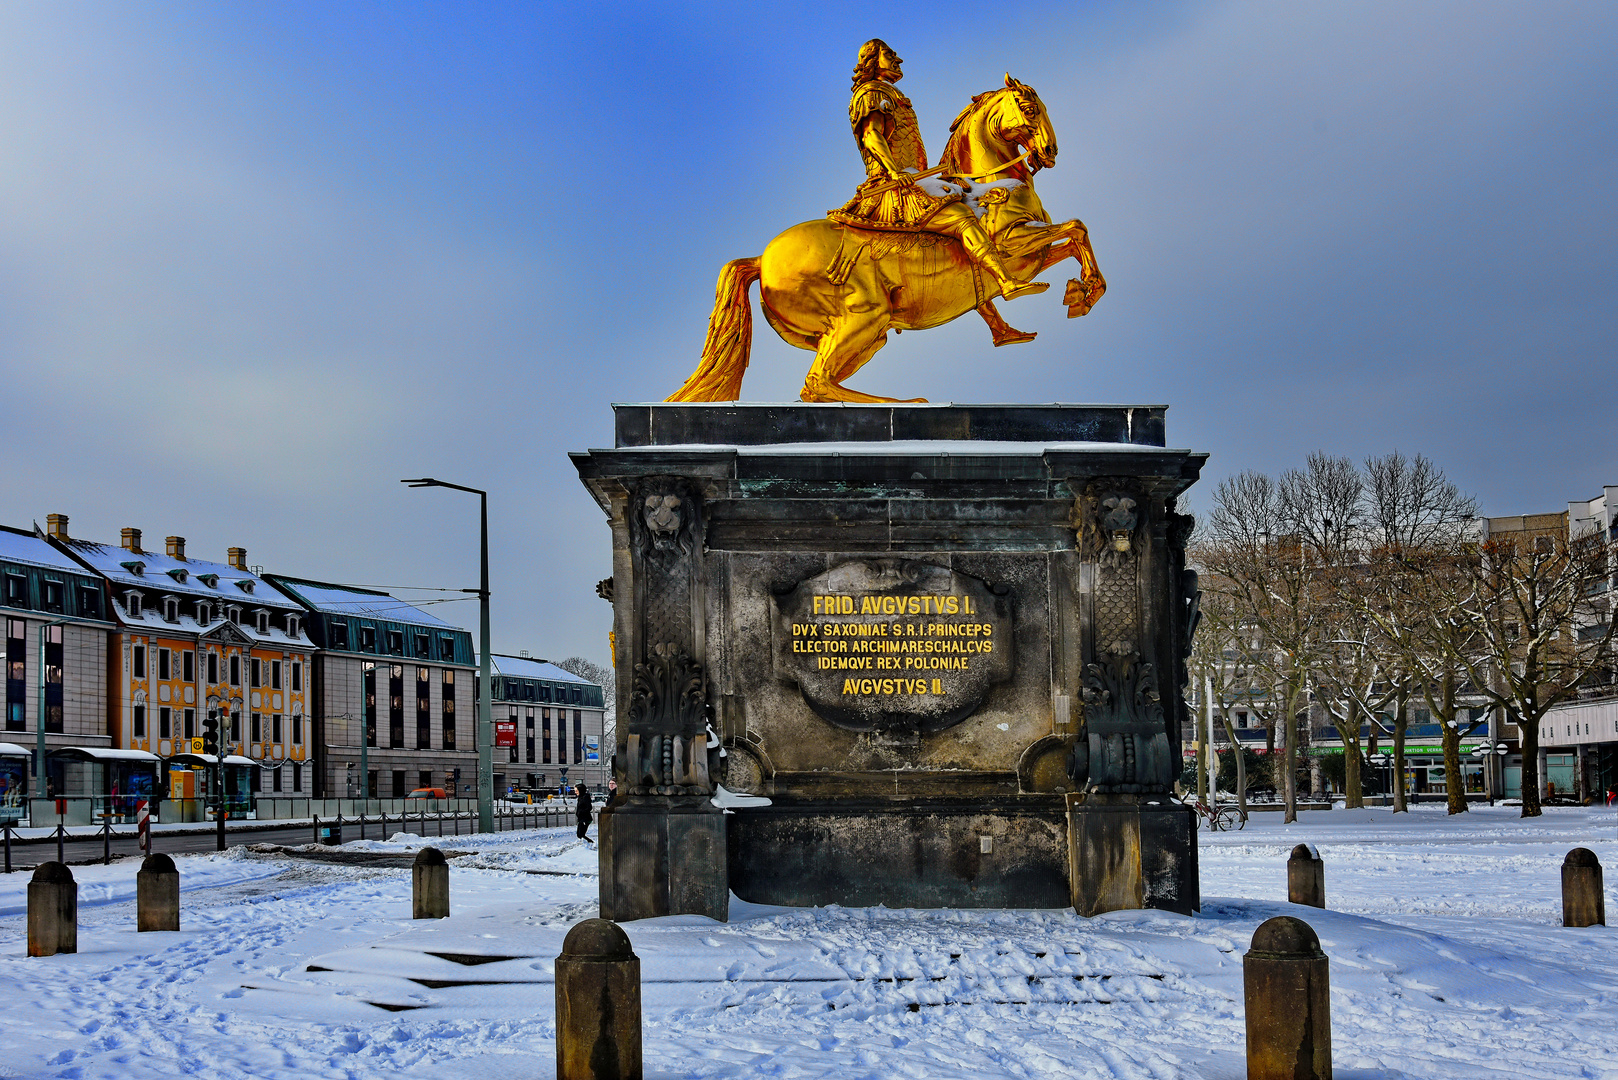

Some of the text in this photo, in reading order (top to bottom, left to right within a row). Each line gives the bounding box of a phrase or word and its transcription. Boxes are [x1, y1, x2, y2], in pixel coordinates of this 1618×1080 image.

[813, 595, 975, 615] FRID. AVGVSTVS I.
[792, 623, 818, 637] DVX
[823, 623, 888, 637] SAXONIAE
[793, 640, 993, 653] ELECTOR ARCHIMARESCHALCVS
[817, 656, 969, 670] IDEMQVE REX POLONIAE
[842, 678, 927, 695] AVGVSTVS
